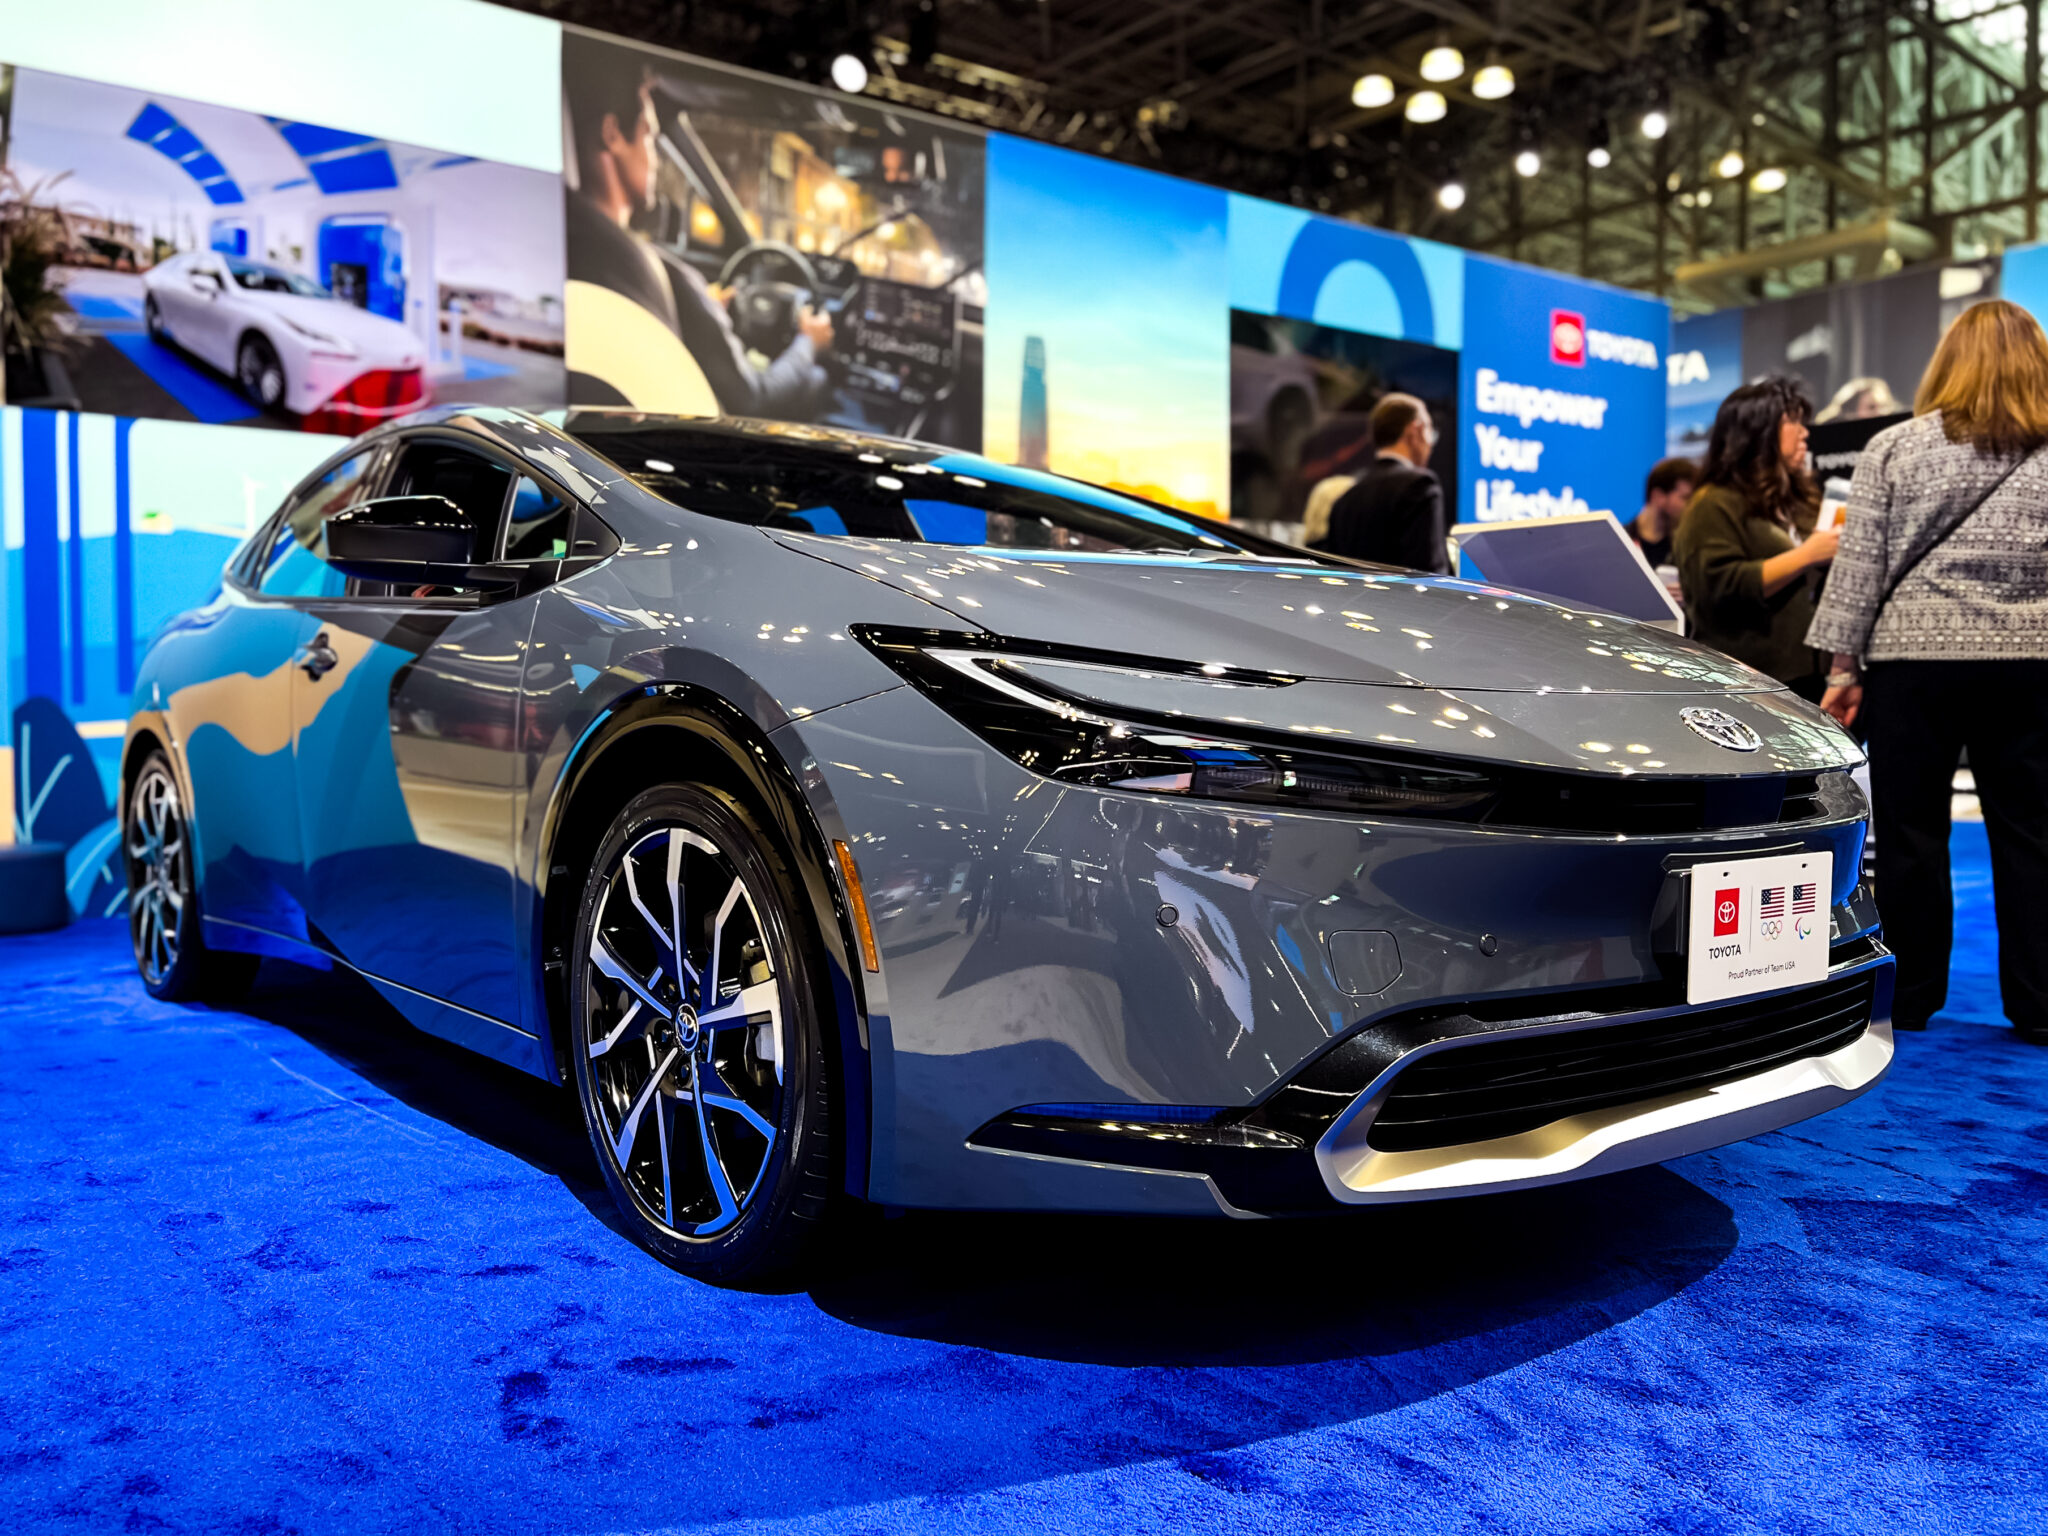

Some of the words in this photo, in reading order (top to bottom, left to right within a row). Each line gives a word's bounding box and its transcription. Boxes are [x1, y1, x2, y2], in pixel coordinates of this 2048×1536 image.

[1587, 329, 1658, 370] TOYOTA
[1476, 368, 1608, 428] Empower
[1475, 422, 1543, 473] Your
[1709, 944, 1742, 960] TOYOTA
[1728, 971, 1744, 980] Proud
[1744, 968, 1763, 977] Partner
[1764, 964, 1770, 974] of
[1771, 963, 1784, 973] Team
[1784, 960, 1796, 970] USA
